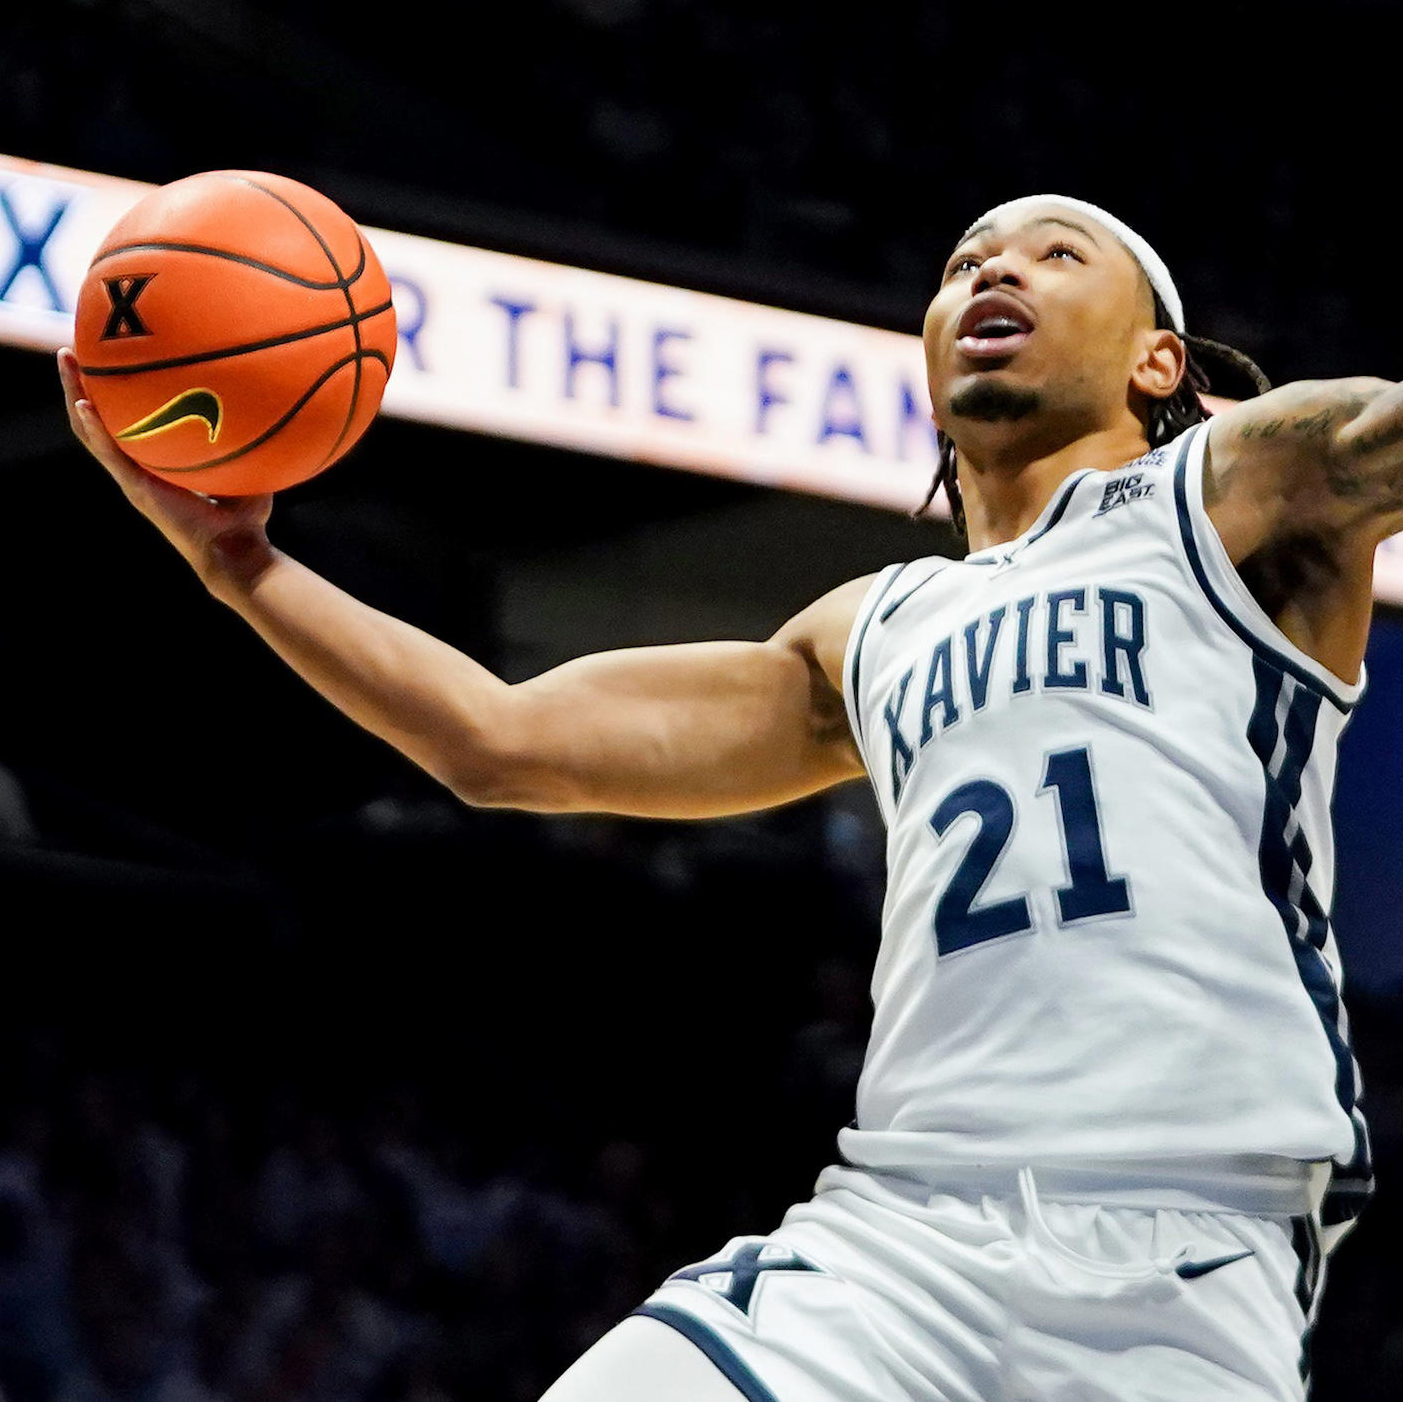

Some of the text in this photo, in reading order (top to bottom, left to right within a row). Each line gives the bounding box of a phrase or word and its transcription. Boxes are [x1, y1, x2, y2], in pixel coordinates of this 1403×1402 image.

[100, 273, 158, 340] X
[490, 297, 694, 422] THE
[1104, 473, 1144, 496] BIG
[884, 586, 1155, 806] XAVIER
[928, 742, 1136, 960] 21
